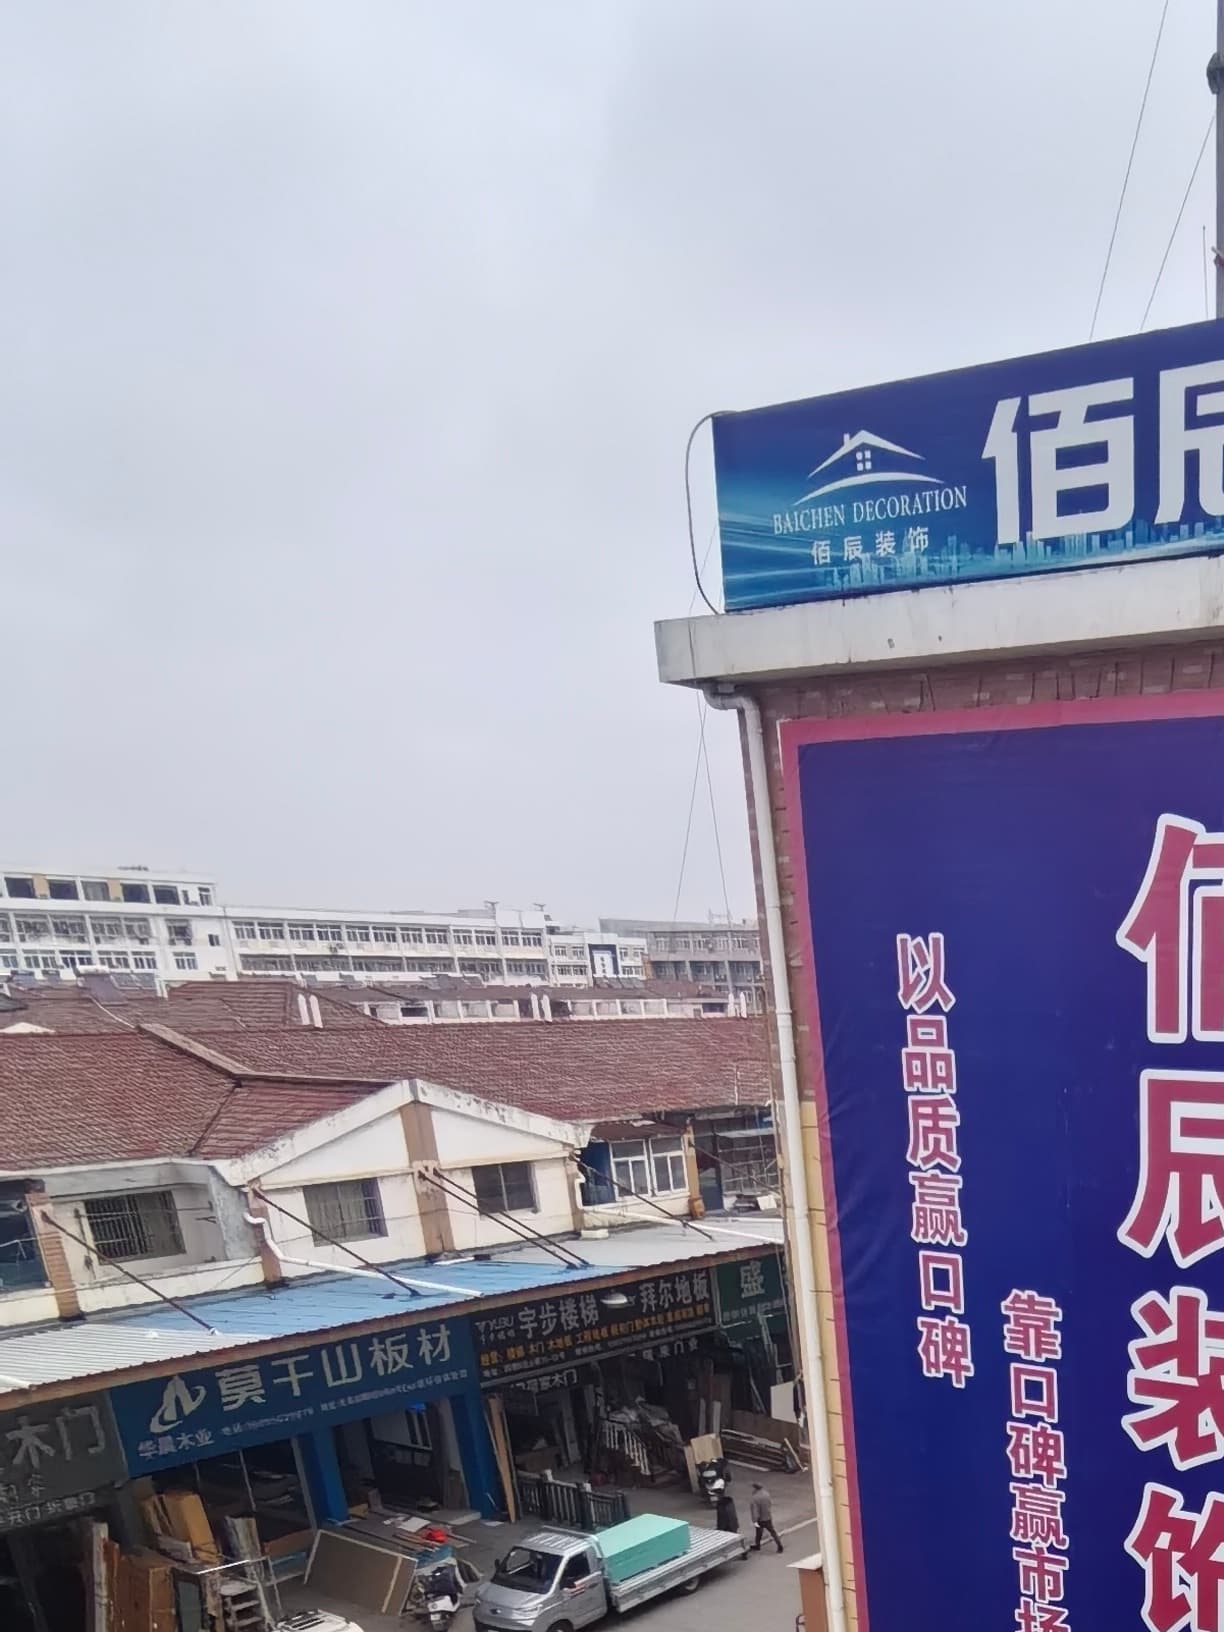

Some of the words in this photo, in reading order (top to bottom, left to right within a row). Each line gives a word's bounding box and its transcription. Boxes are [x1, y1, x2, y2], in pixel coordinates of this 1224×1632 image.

[773, 504, 846, 535] BAICHEN
[853, 485, 967, 523] DECORATION
[811, 526, 929, 565] 佰辰装饰
[896, 931, 974, 1389] 以品质赢口碑
[639, 1270, 710, 1313] 拜尔地板
[215, 1323, 451, 1412] 莫干山板材
[5, 1405, 106, 1469] 木门
